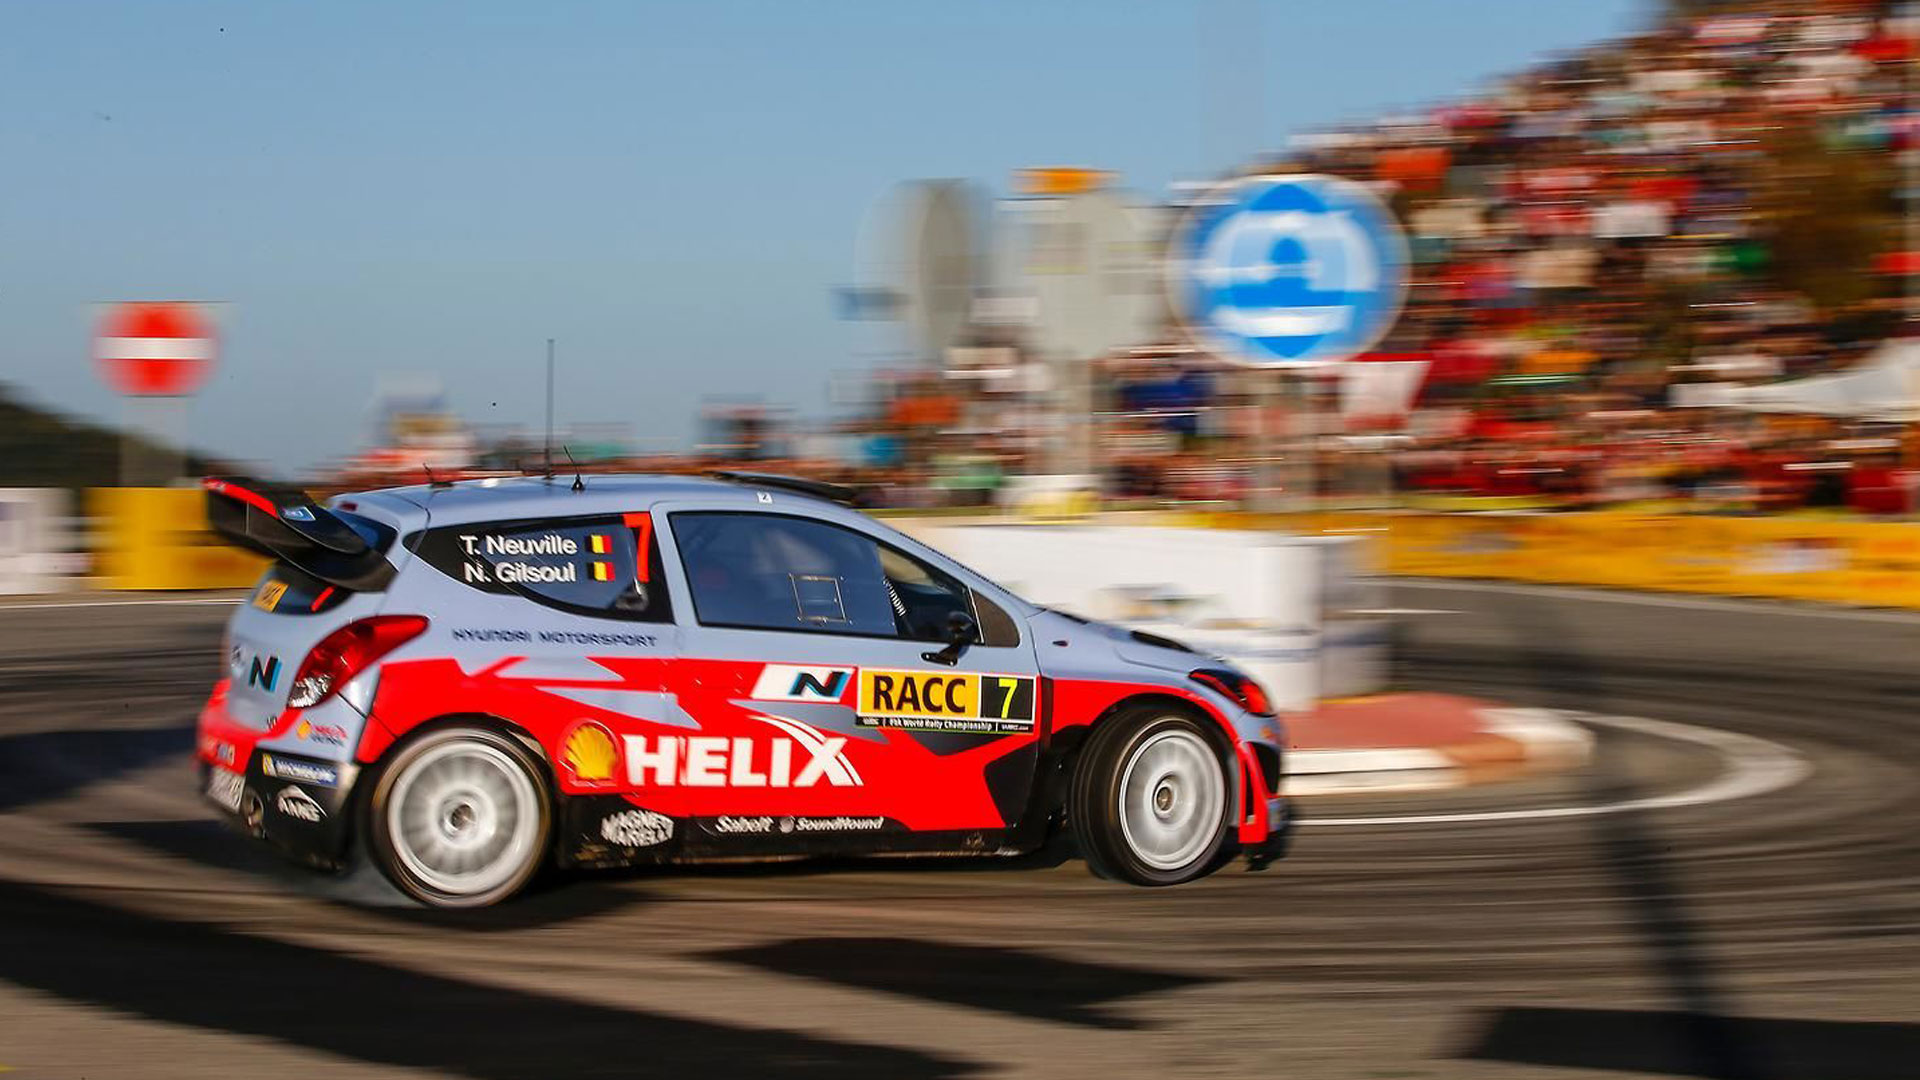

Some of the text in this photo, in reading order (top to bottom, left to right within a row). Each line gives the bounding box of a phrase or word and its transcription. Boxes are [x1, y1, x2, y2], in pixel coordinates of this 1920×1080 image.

[459, 534, 578, 556] T. Neuville
[623, 511, 652, 583] 7
[463, 561, 577, 583] N. Gilsoul
[451, 628, 658, 647] HYUNDAI MOTORSPORT
[872, 674, 1019, 719] RACC 7
[944, 720, 993, 732] Championship
[620, 715, 865, 787] HELIX
[796, 815, 885, 831] SoundHound
